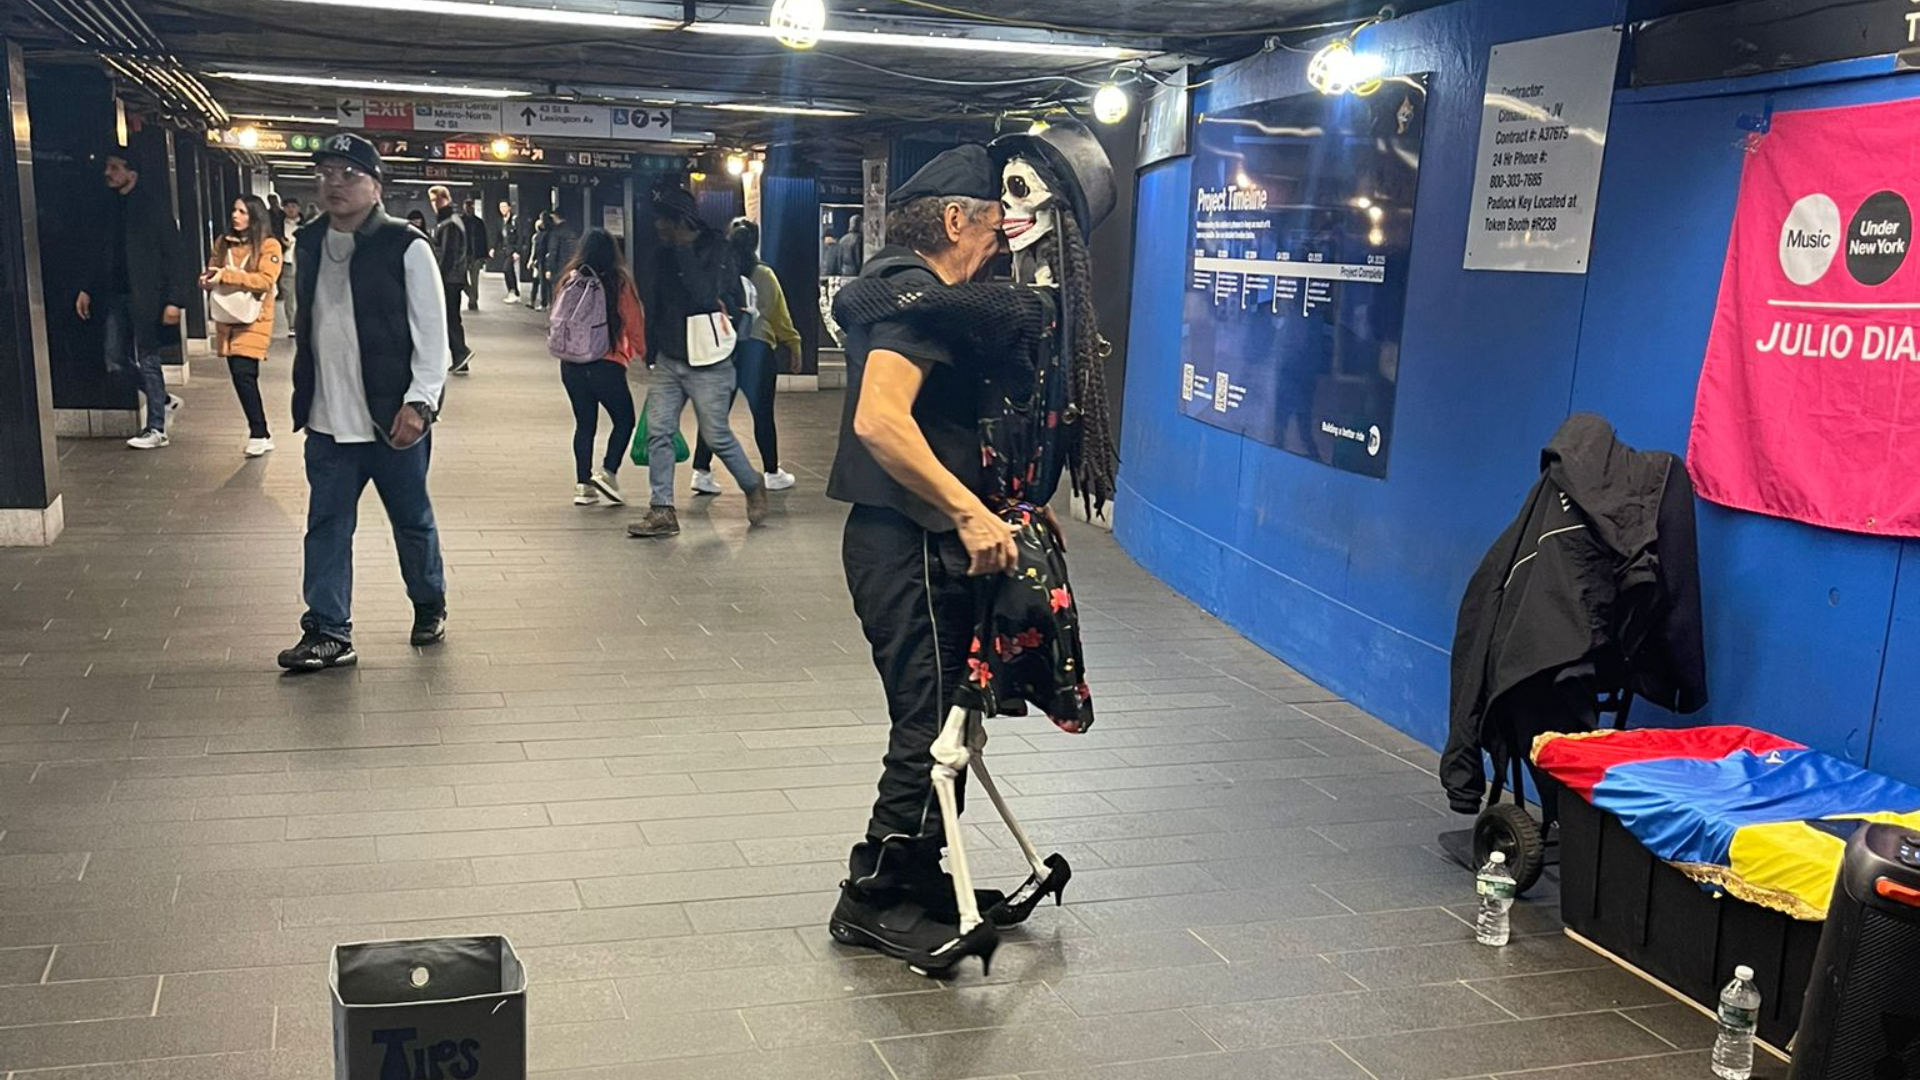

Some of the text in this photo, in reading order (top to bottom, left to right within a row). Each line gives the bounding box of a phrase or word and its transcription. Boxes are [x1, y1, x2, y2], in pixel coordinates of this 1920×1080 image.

[365, 98, 407, 117] Exit
[434, 110, 492, 121] Metro-North
[434, 119, 459, 129] 42 St
[539, 114, 581, 124] Lexington
[1496, 129, 1528, 145] Contract
[445, 143, 477, 160] Exit
[1493, 152, 1503, 167] 24
[1504, 152, 1513, 166] Hr
[1514, 151, 1538, 165] Phone
[1197, 185, 1267, 217] Project Timeline
[1487, 194, 1578, 212] Padlock Key Located at
[1485, 217, 1506, 231] Token
[1507, 217, 1530, 231] Booth
[1860, 219, 1900, 237] Under
[1786, 228, 1831, 249] Music
[1359, 266, 1383, 280] Complete
[1755, 321, 1920, 361] JULIO DIA
